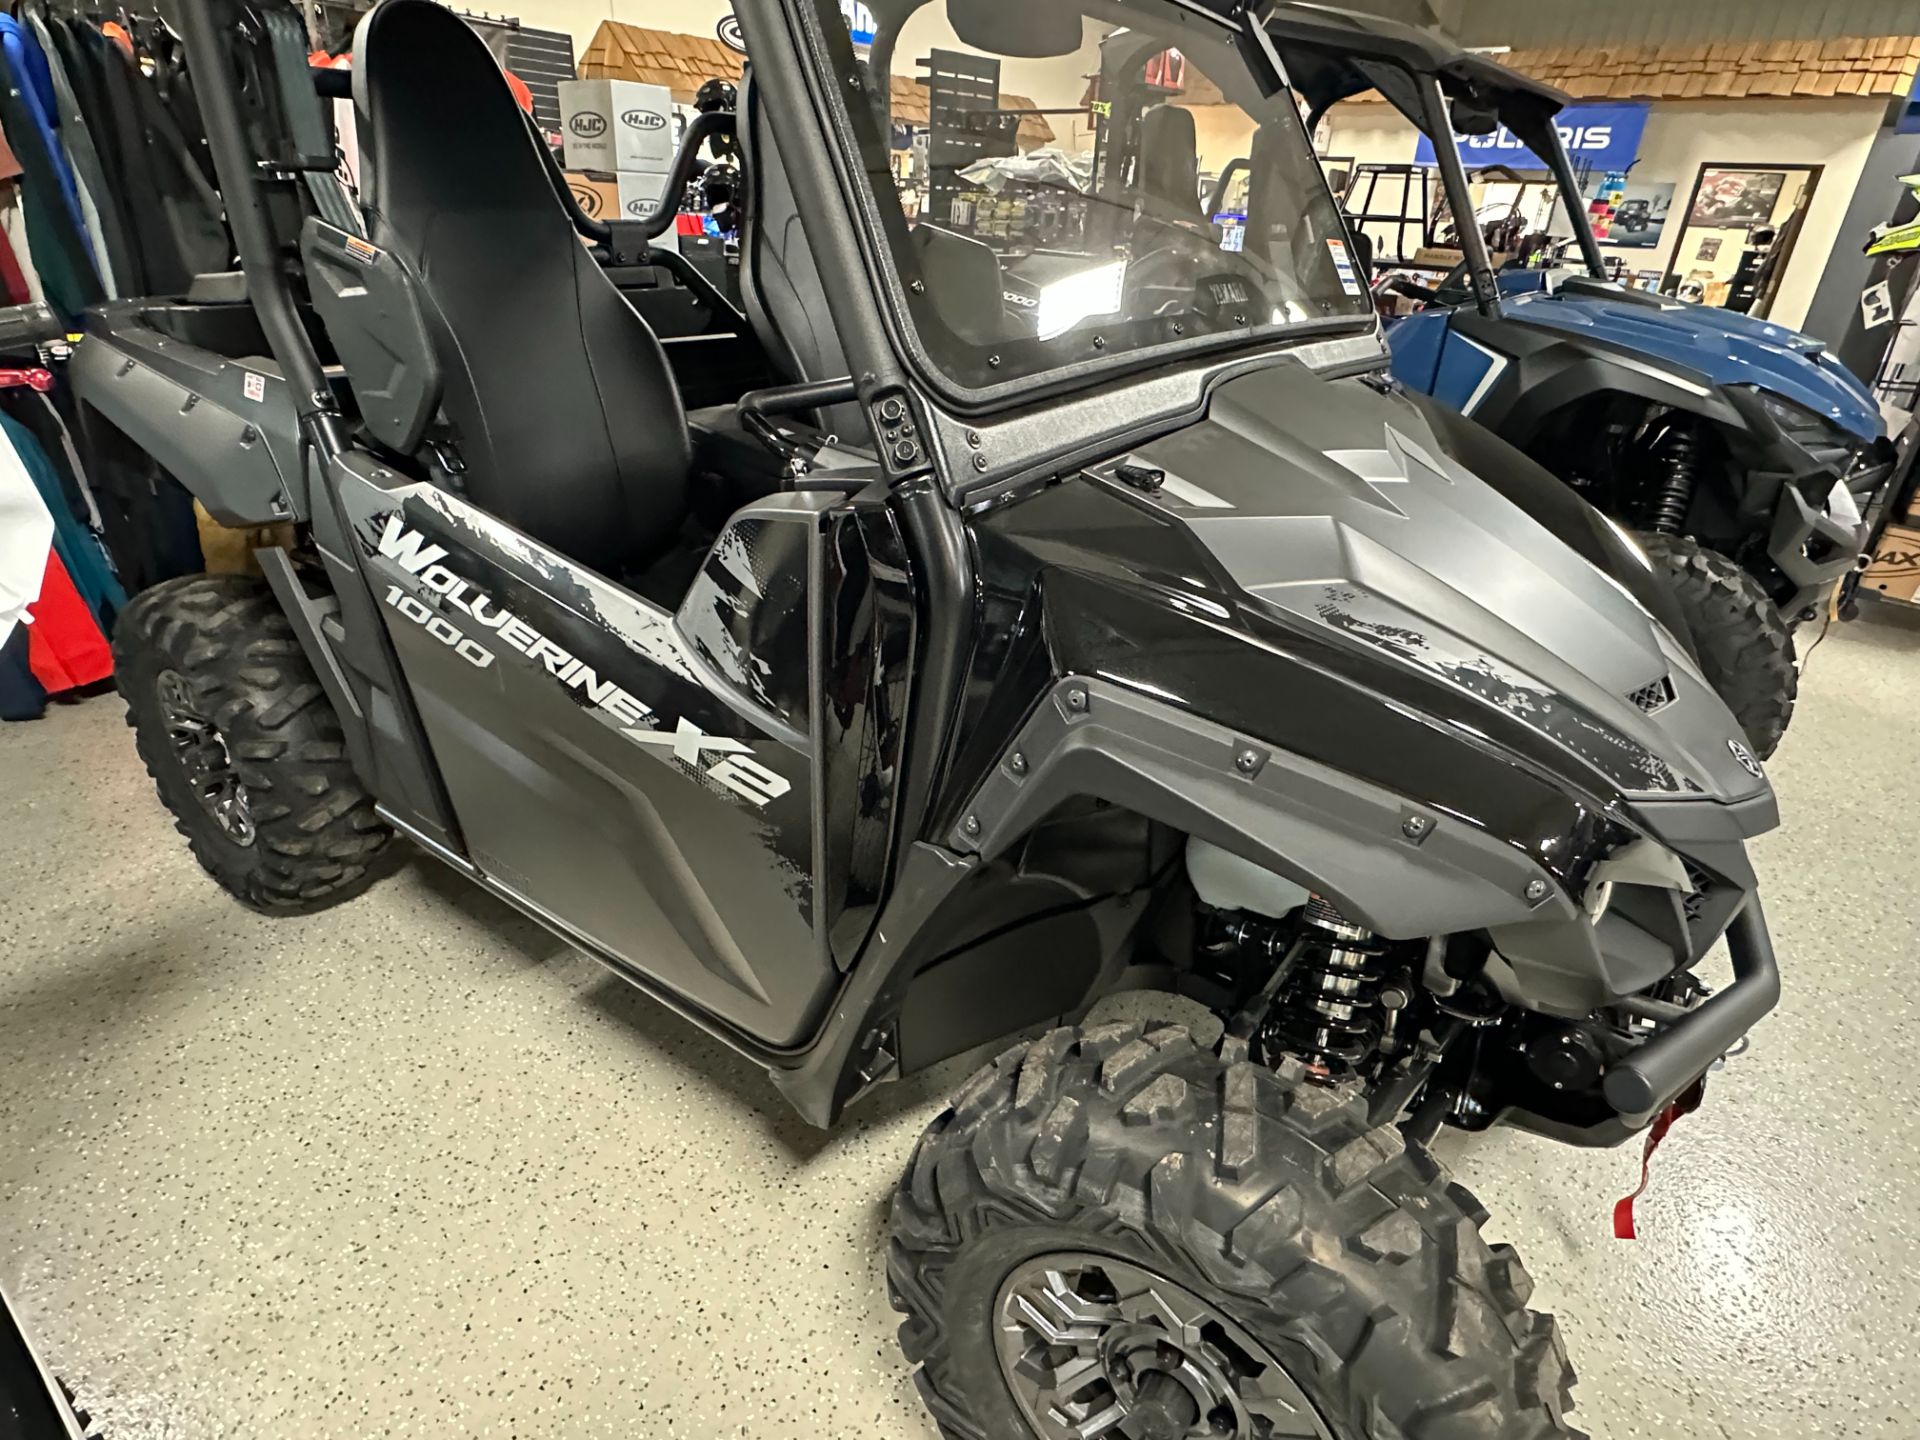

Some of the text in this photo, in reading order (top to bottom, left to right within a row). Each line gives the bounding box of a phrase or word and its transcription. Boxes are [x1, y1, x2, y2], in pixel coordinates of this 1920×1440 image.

[574, 118, 601, 131] HJC
[627, 114, 661, 127] HJC
[385, 585, 496, 668] 1000
[378, 515, 792, 806] WOLVERINE X2
